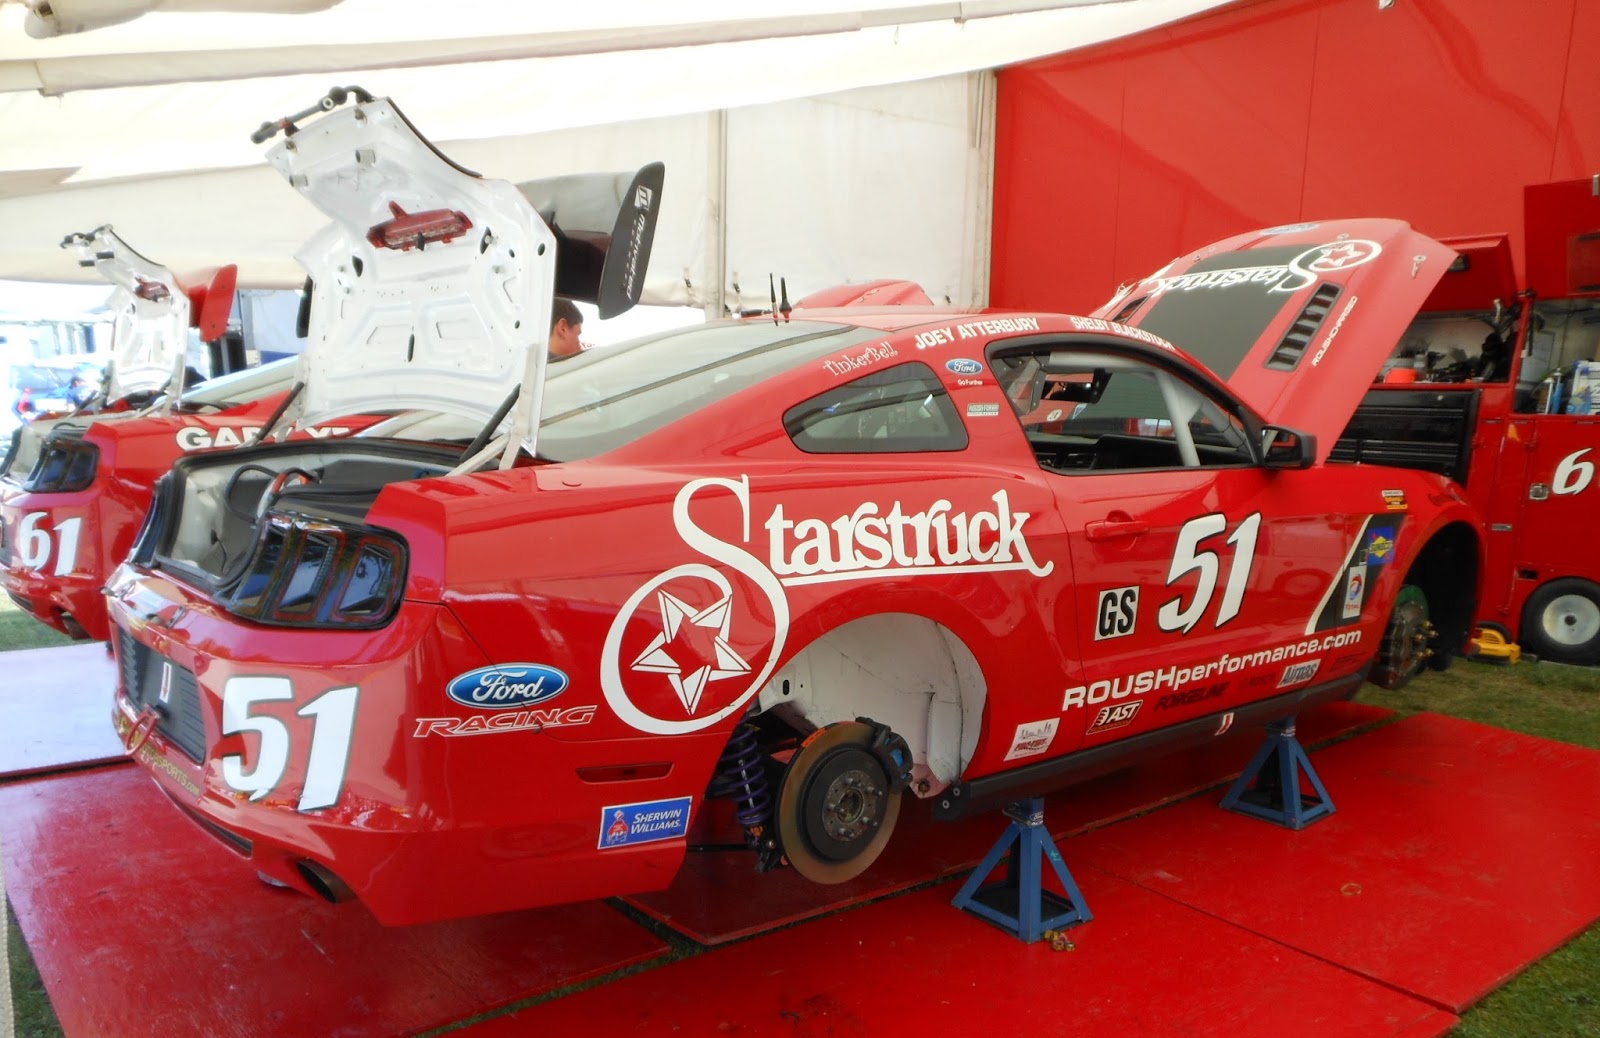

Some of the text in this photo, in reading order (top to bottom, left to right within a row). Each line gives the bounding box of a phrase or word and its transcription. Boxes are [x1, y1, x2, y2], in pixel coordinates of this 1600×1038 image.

[1140, 239, 1382, 298] Starstruck
[914, 317, 1041, 350] JOEY ATTERBURY
[1070, 317, 1110, 331] SHELBY
[20, 511, 81, 577] 61
[1158, 512, 1261, 634] 51
[600, 474, 1054, 735] Starstruck
[1098, 589, 1137, 637] GS
[472, 670, 546, 702] Ford
[1062, 630, 1362, 711] ROUSHperformance.com
[413, 705, 598, 738] RACING
[1106, 702, 1140, 724] AST
[222, 676, 360, 812] 51
[633, 809, 682, 824] SHERWIN
